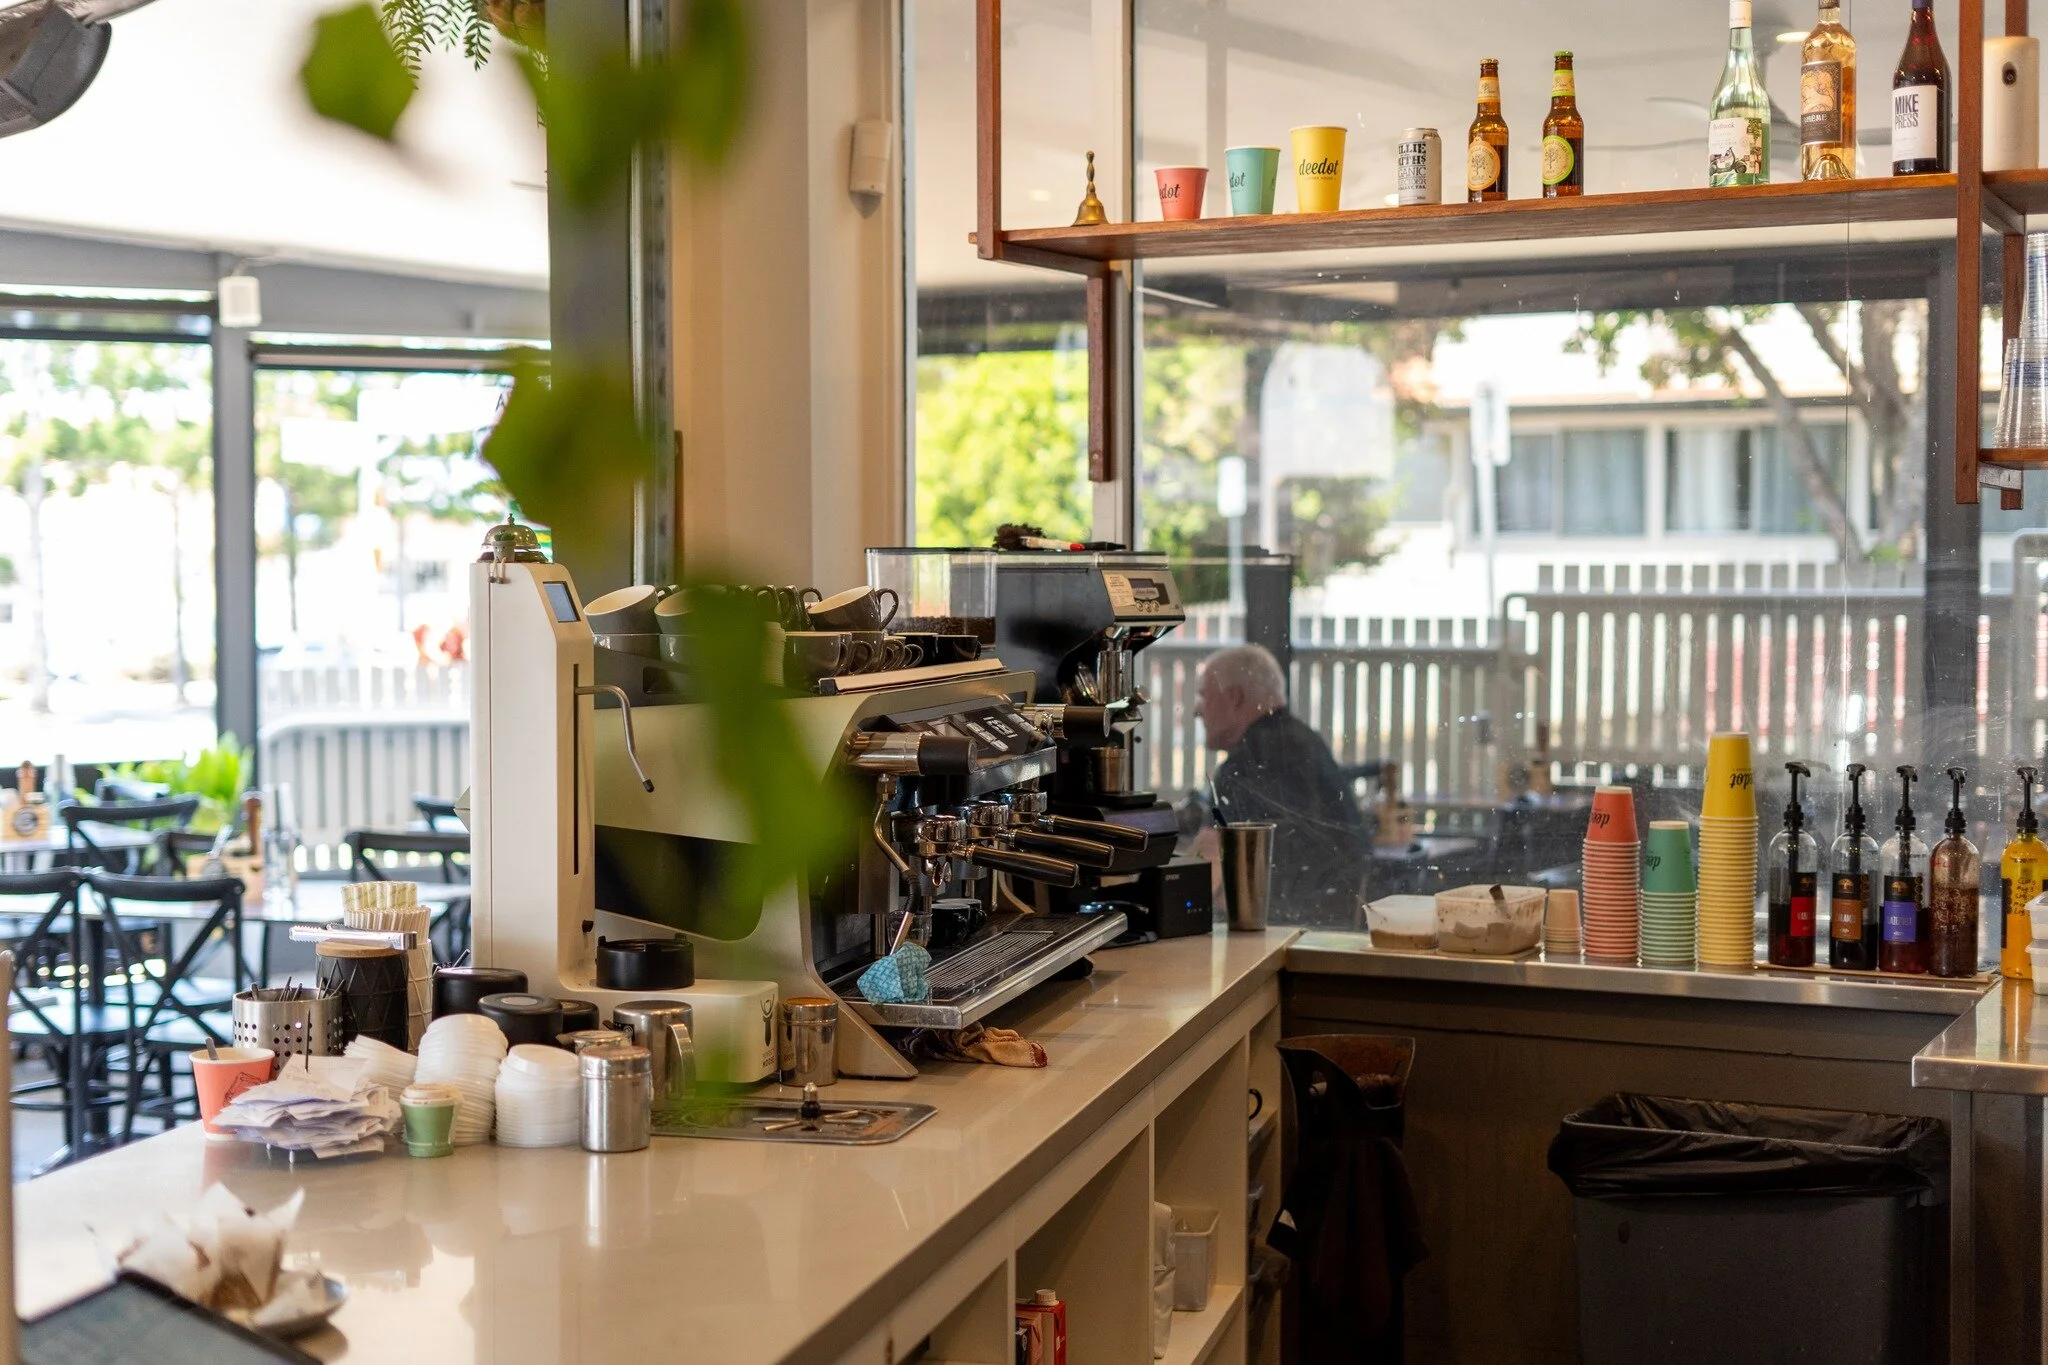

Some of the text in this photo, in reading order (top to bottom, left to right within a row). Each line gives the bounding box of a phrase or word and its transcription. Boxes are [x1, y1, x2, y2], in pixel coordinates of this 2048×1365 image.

[1894, 94, 1919, 115] MIKE
[1894, 113, 1919, 130] PRESS
[1298, 157, 1339, 176] deedot
